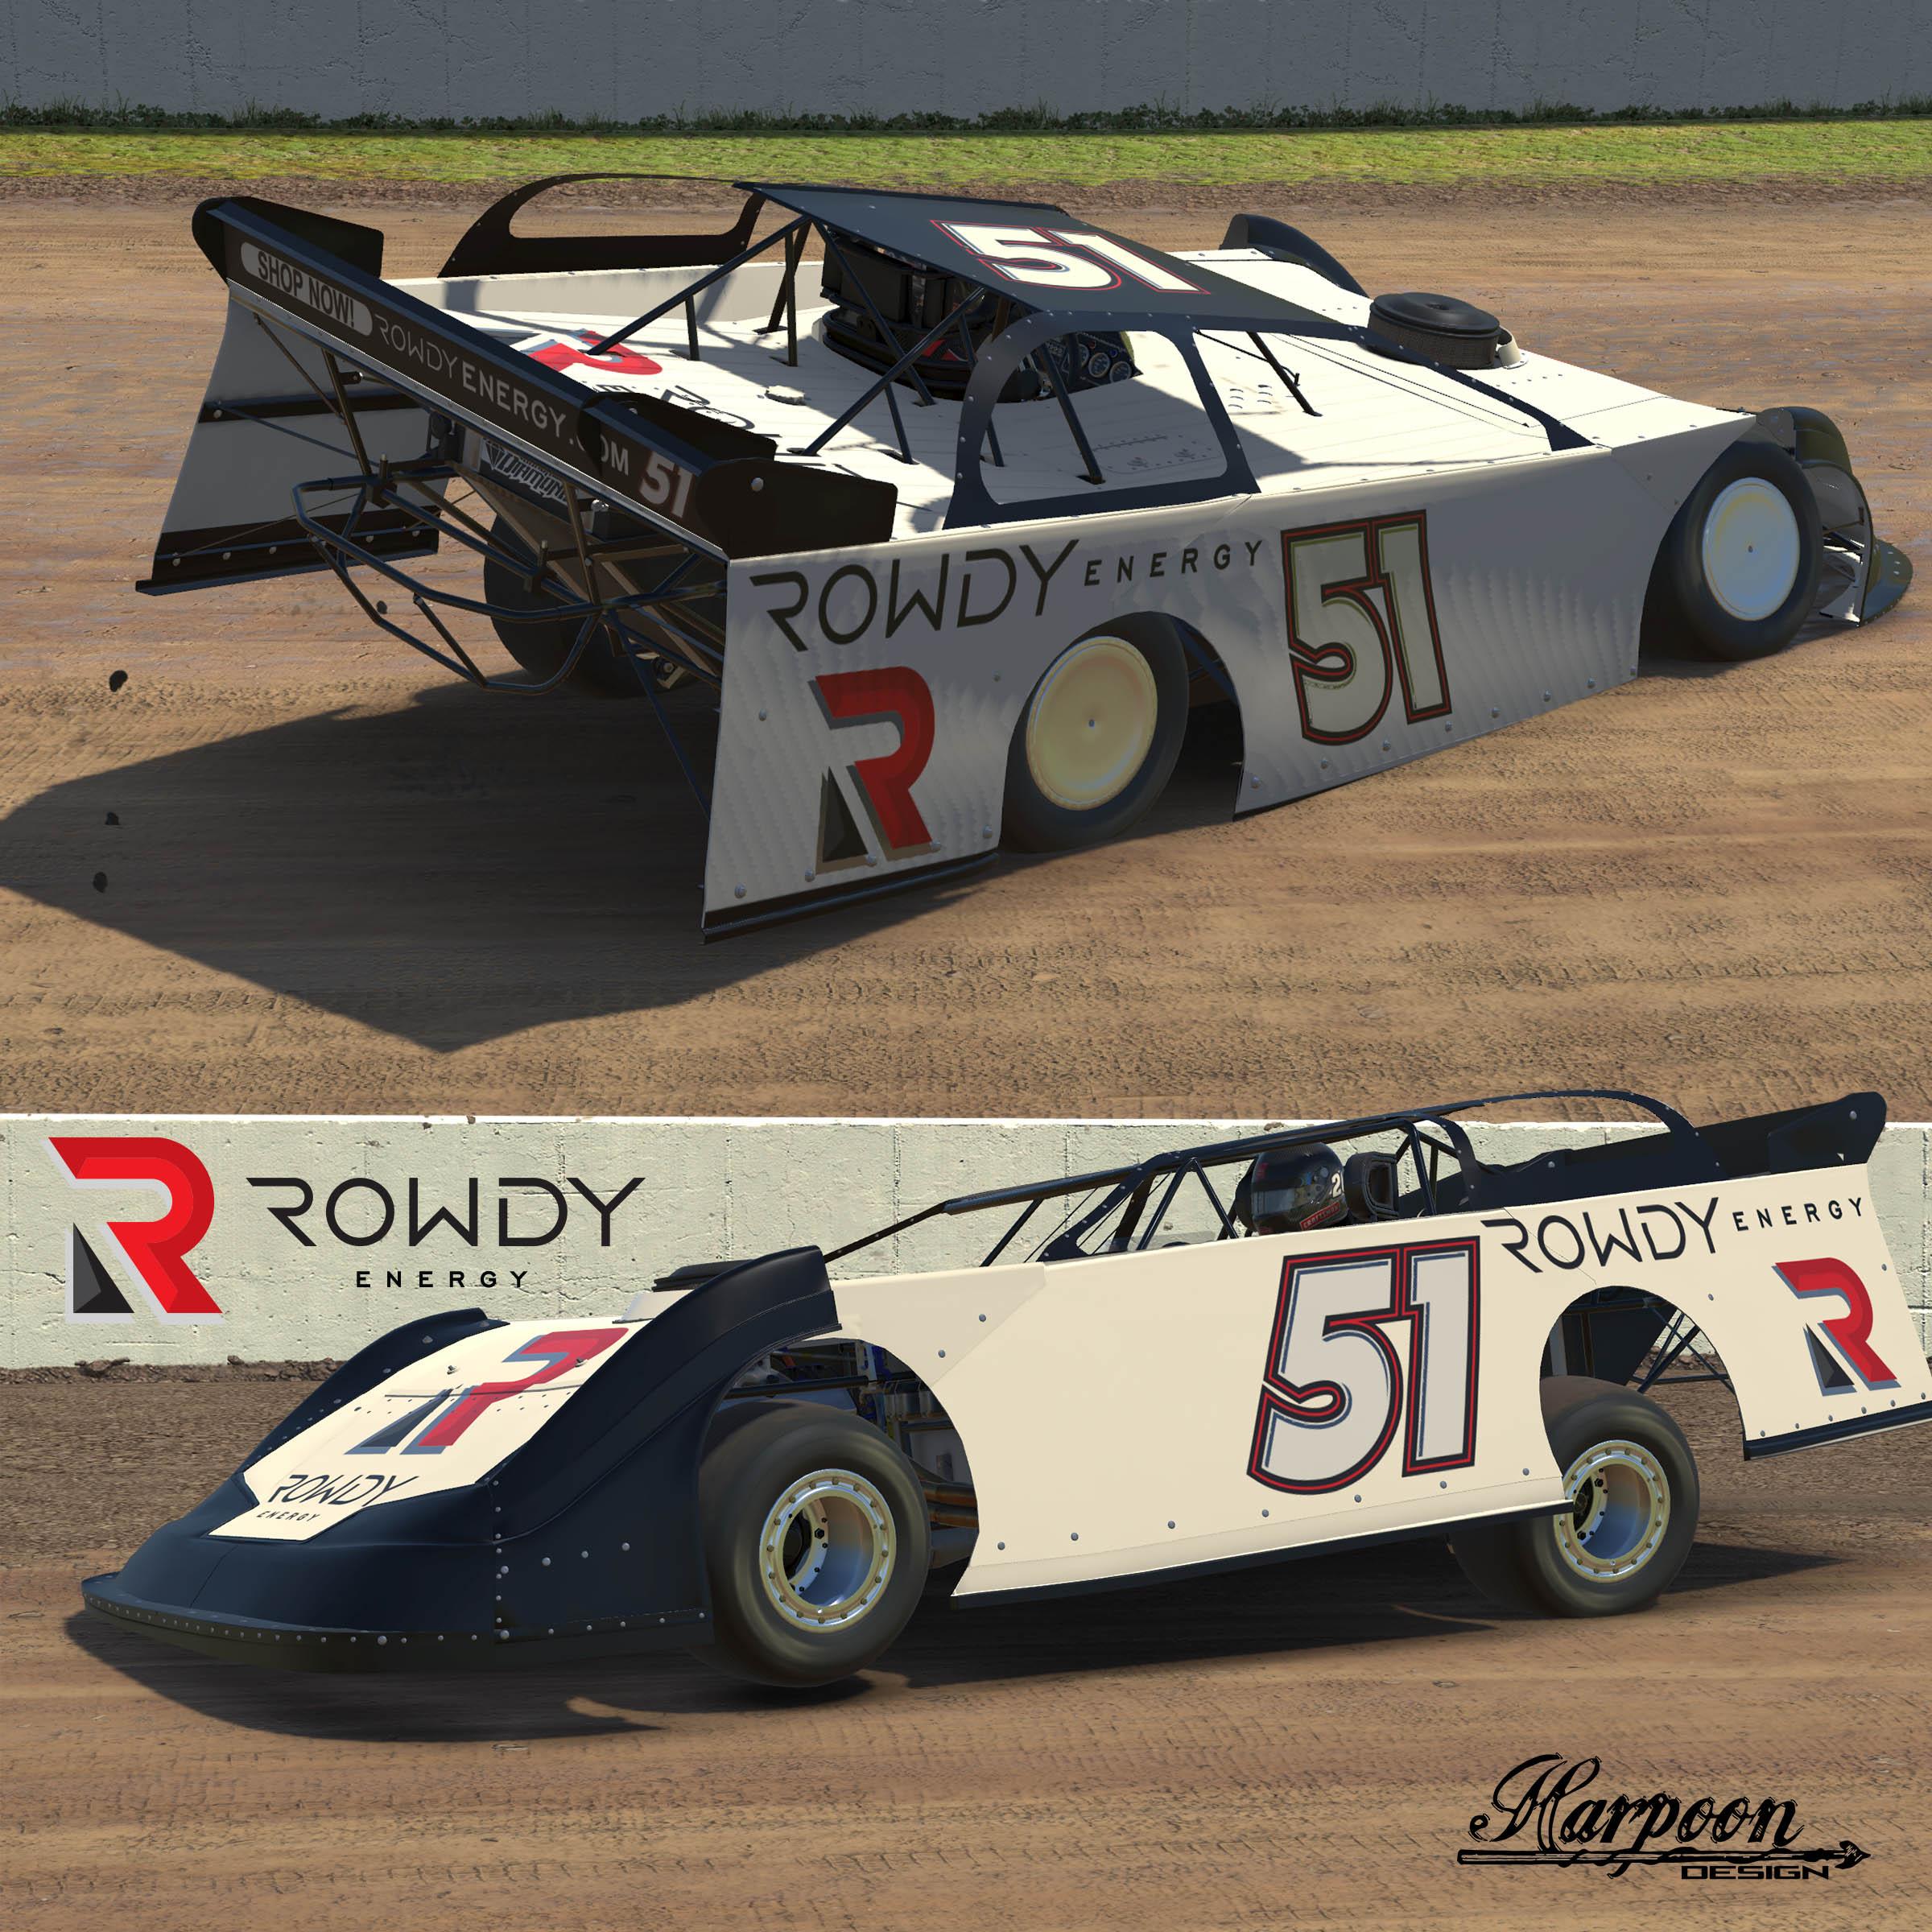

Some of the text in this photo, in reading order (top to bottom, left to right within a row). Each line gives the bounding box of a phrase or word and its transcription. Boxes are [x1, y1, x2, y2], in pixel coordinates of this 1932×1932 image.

[258, 250, 355, 328] SHOP NOW!
[929, 219, 1212, 295] 51
[638, 449, 694, 518] 51
[749, 538, 1264, 652] ROWDY ENERGY
[1281, 509, 1452, 747] 51
[807, 666, 937, 875] R
[1480, 1196, 1863, 1274] ROWDY ENERGY
[1246, 1236, 1481, 1496] 51
[1771, 1257, 1902, 1397] R
[256, 1509, 322, 1523] ENERGY
[267, 1474, 419, 1508] ROWDY
